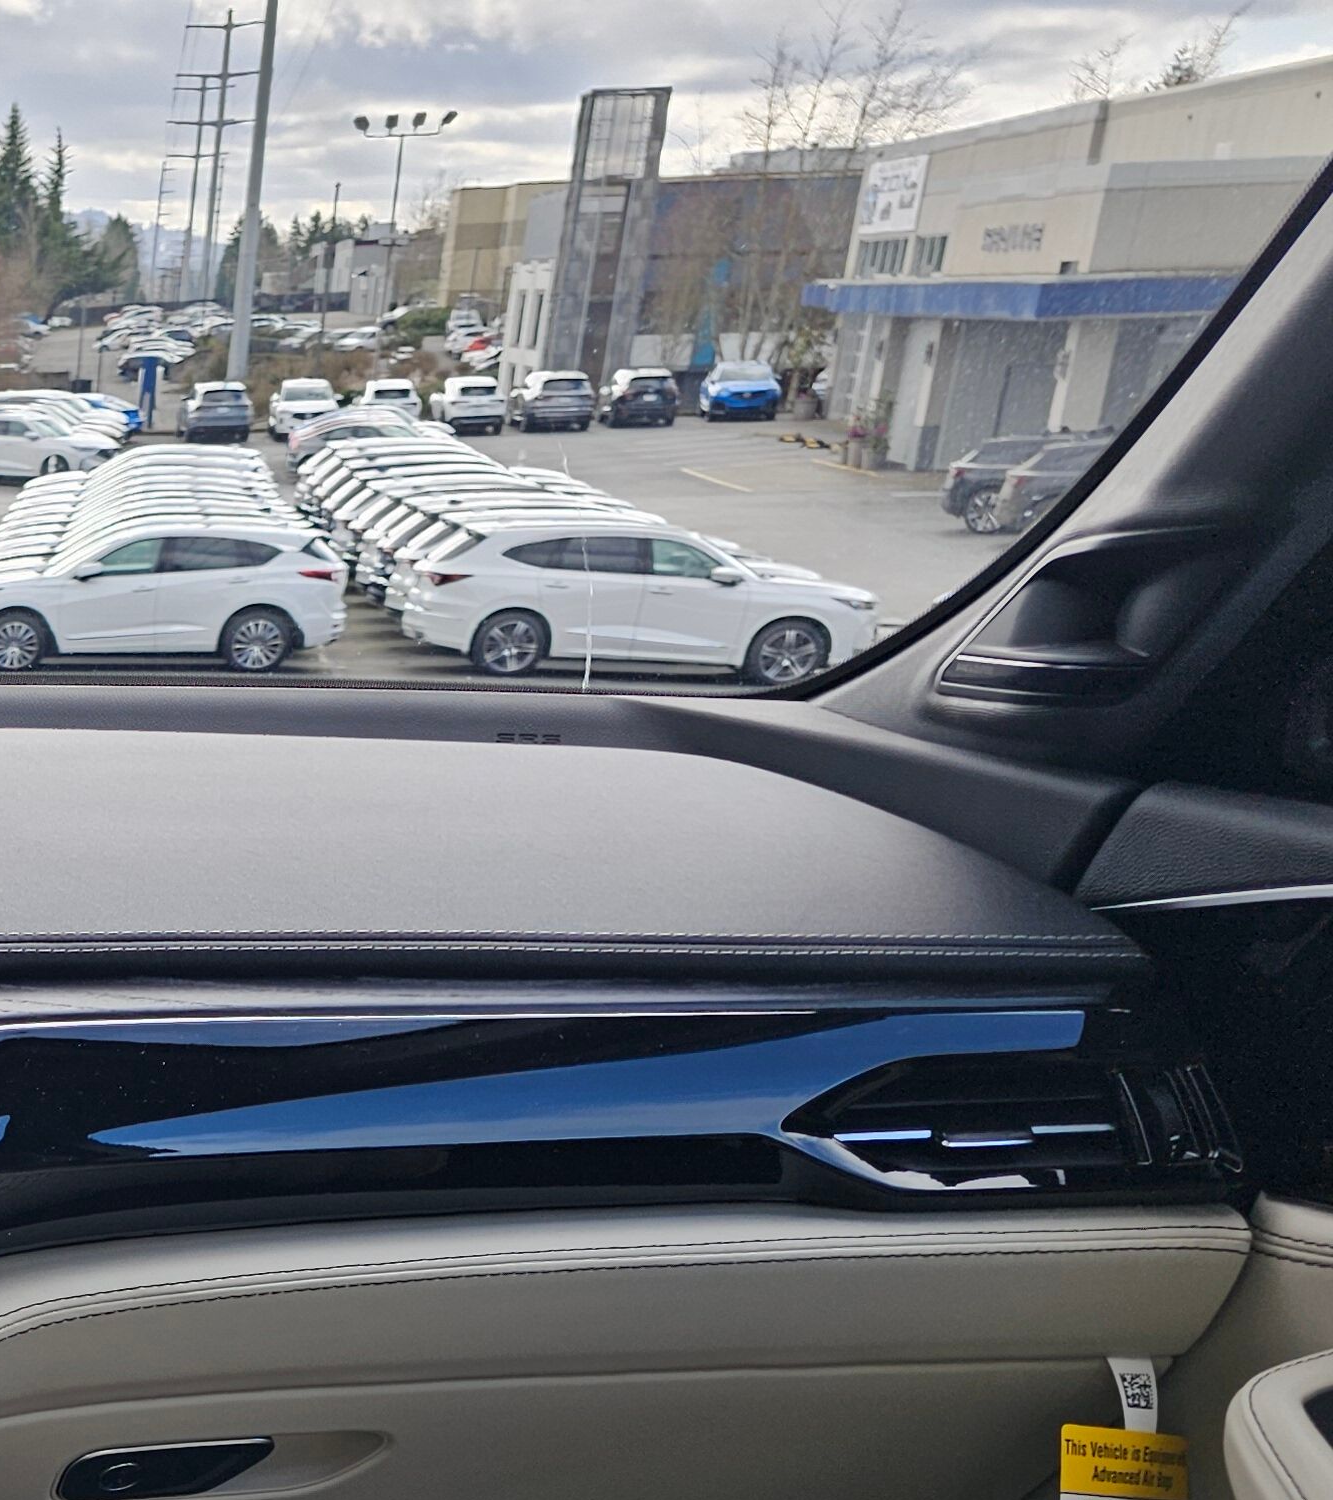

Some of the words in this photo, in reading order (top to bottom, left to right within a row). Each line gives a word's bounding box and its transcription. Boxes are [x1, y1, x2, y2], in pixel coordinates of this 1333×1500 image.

[1064, 1438, 1087, 1457] This
[1090, 1441, 1129, 1461] Vehicle
[1131, 1445, 1141, 1462] is
[1092, 1465, 1141, 1486] Advanced
